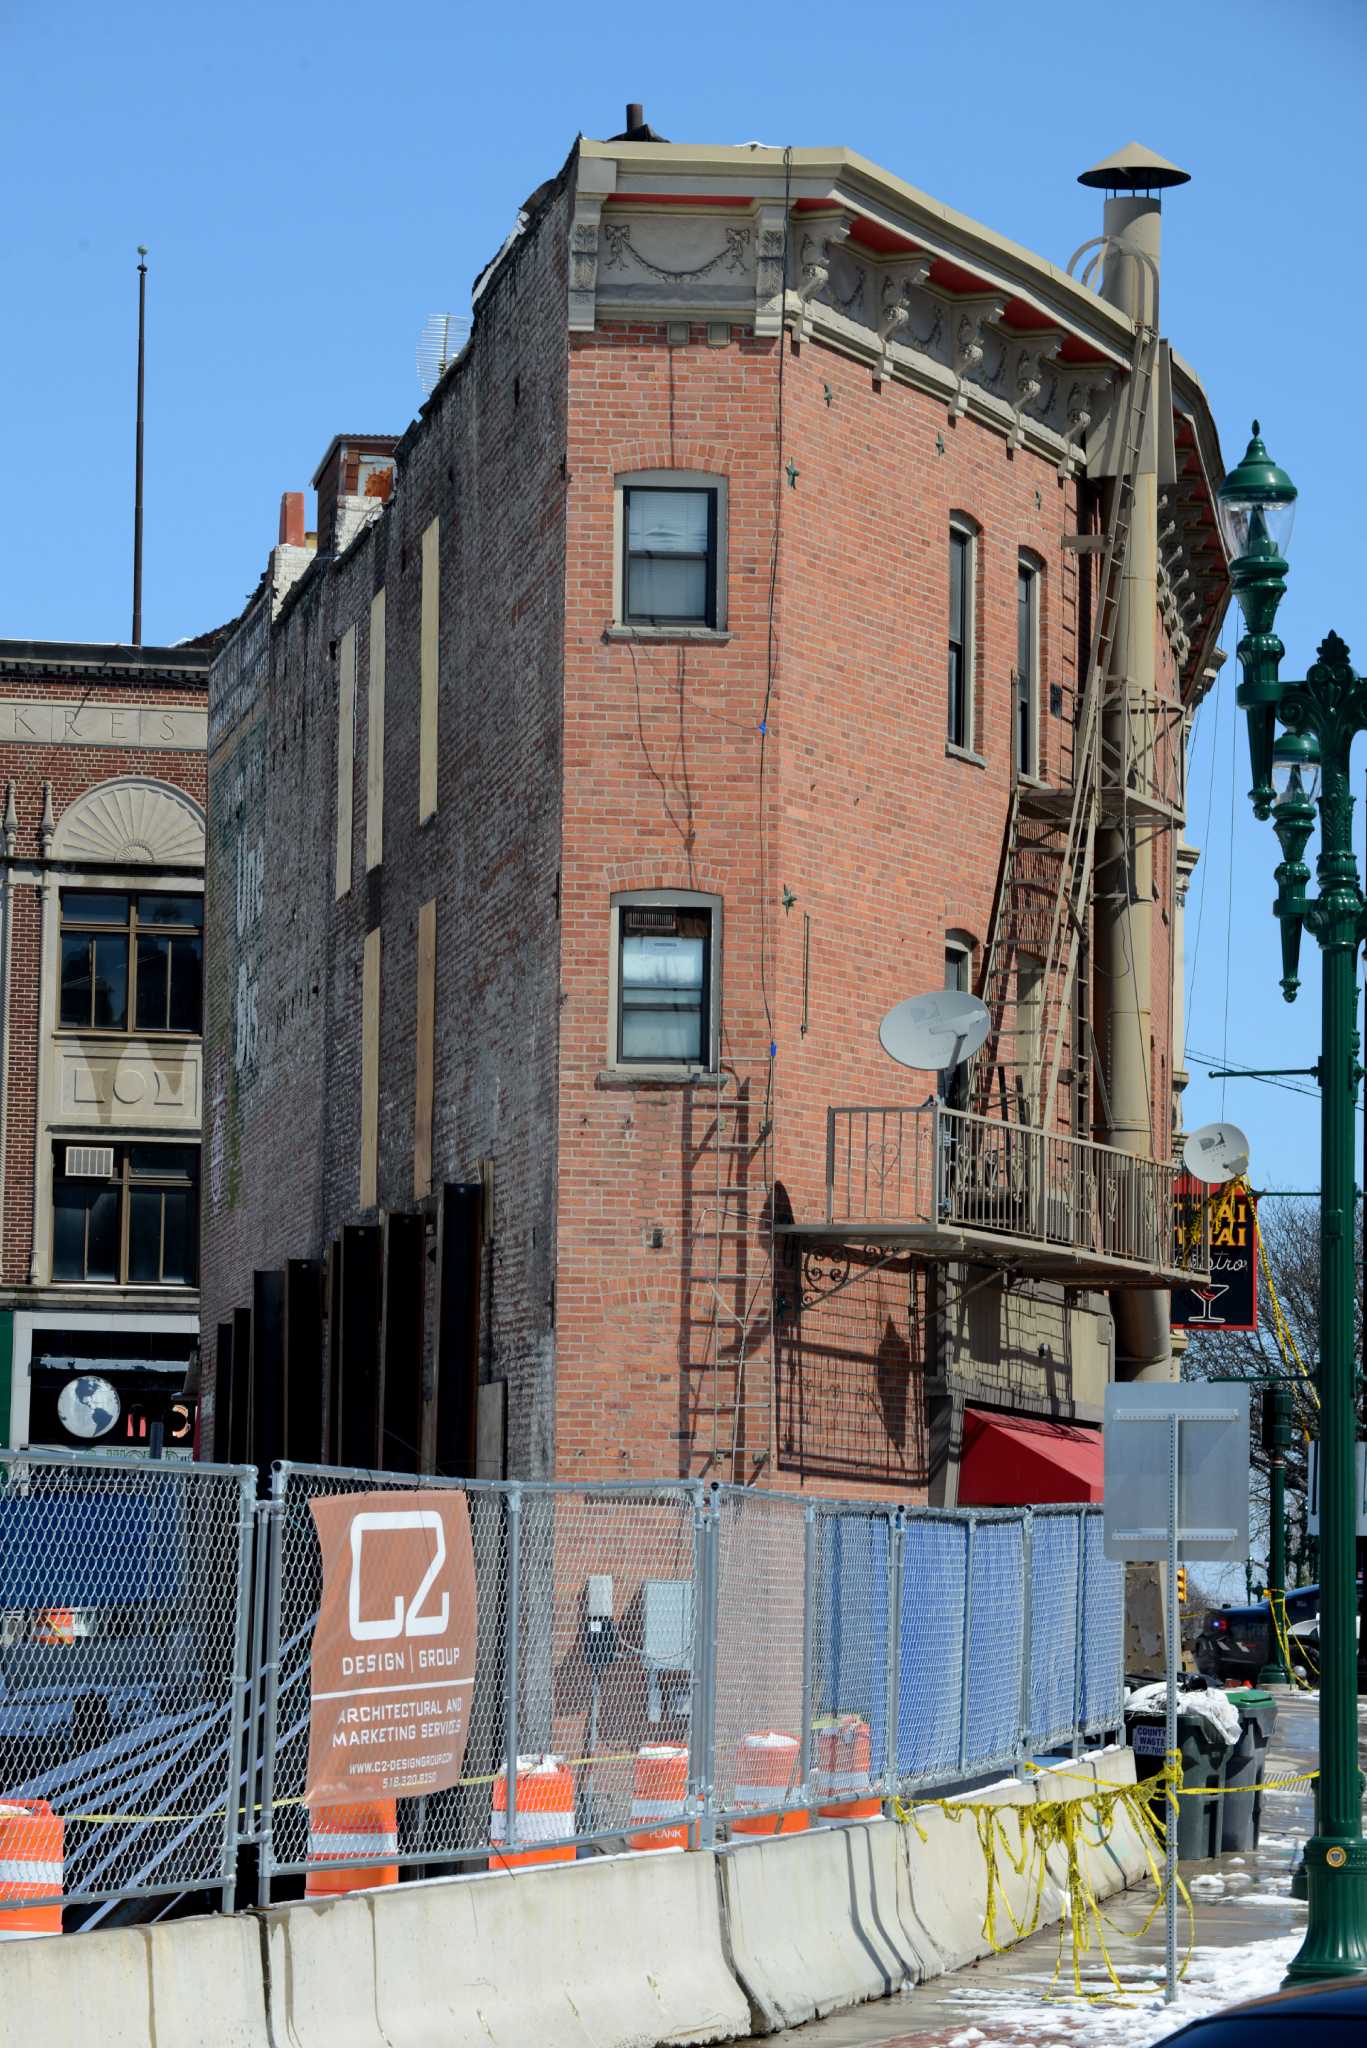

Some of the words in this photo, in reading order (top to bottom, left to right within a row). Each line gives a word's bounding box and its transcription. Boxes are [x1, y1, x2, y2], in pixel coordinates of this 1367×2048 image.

[349, 1510, 449, 1641] C2
[342, 1652, 404, 1676] DESIGN
[419, 1647, 460, 1668] GROUP
[337, 1699, 442, 1725] ARCHITECTURAL
[447, 1696, 462, 1712] AND
[332, 1724, 416, 1748] MARKETING
[421, 1719, 461, 1738] SERVICES
[1137, 1727, 1166, 1736] COUNTY
